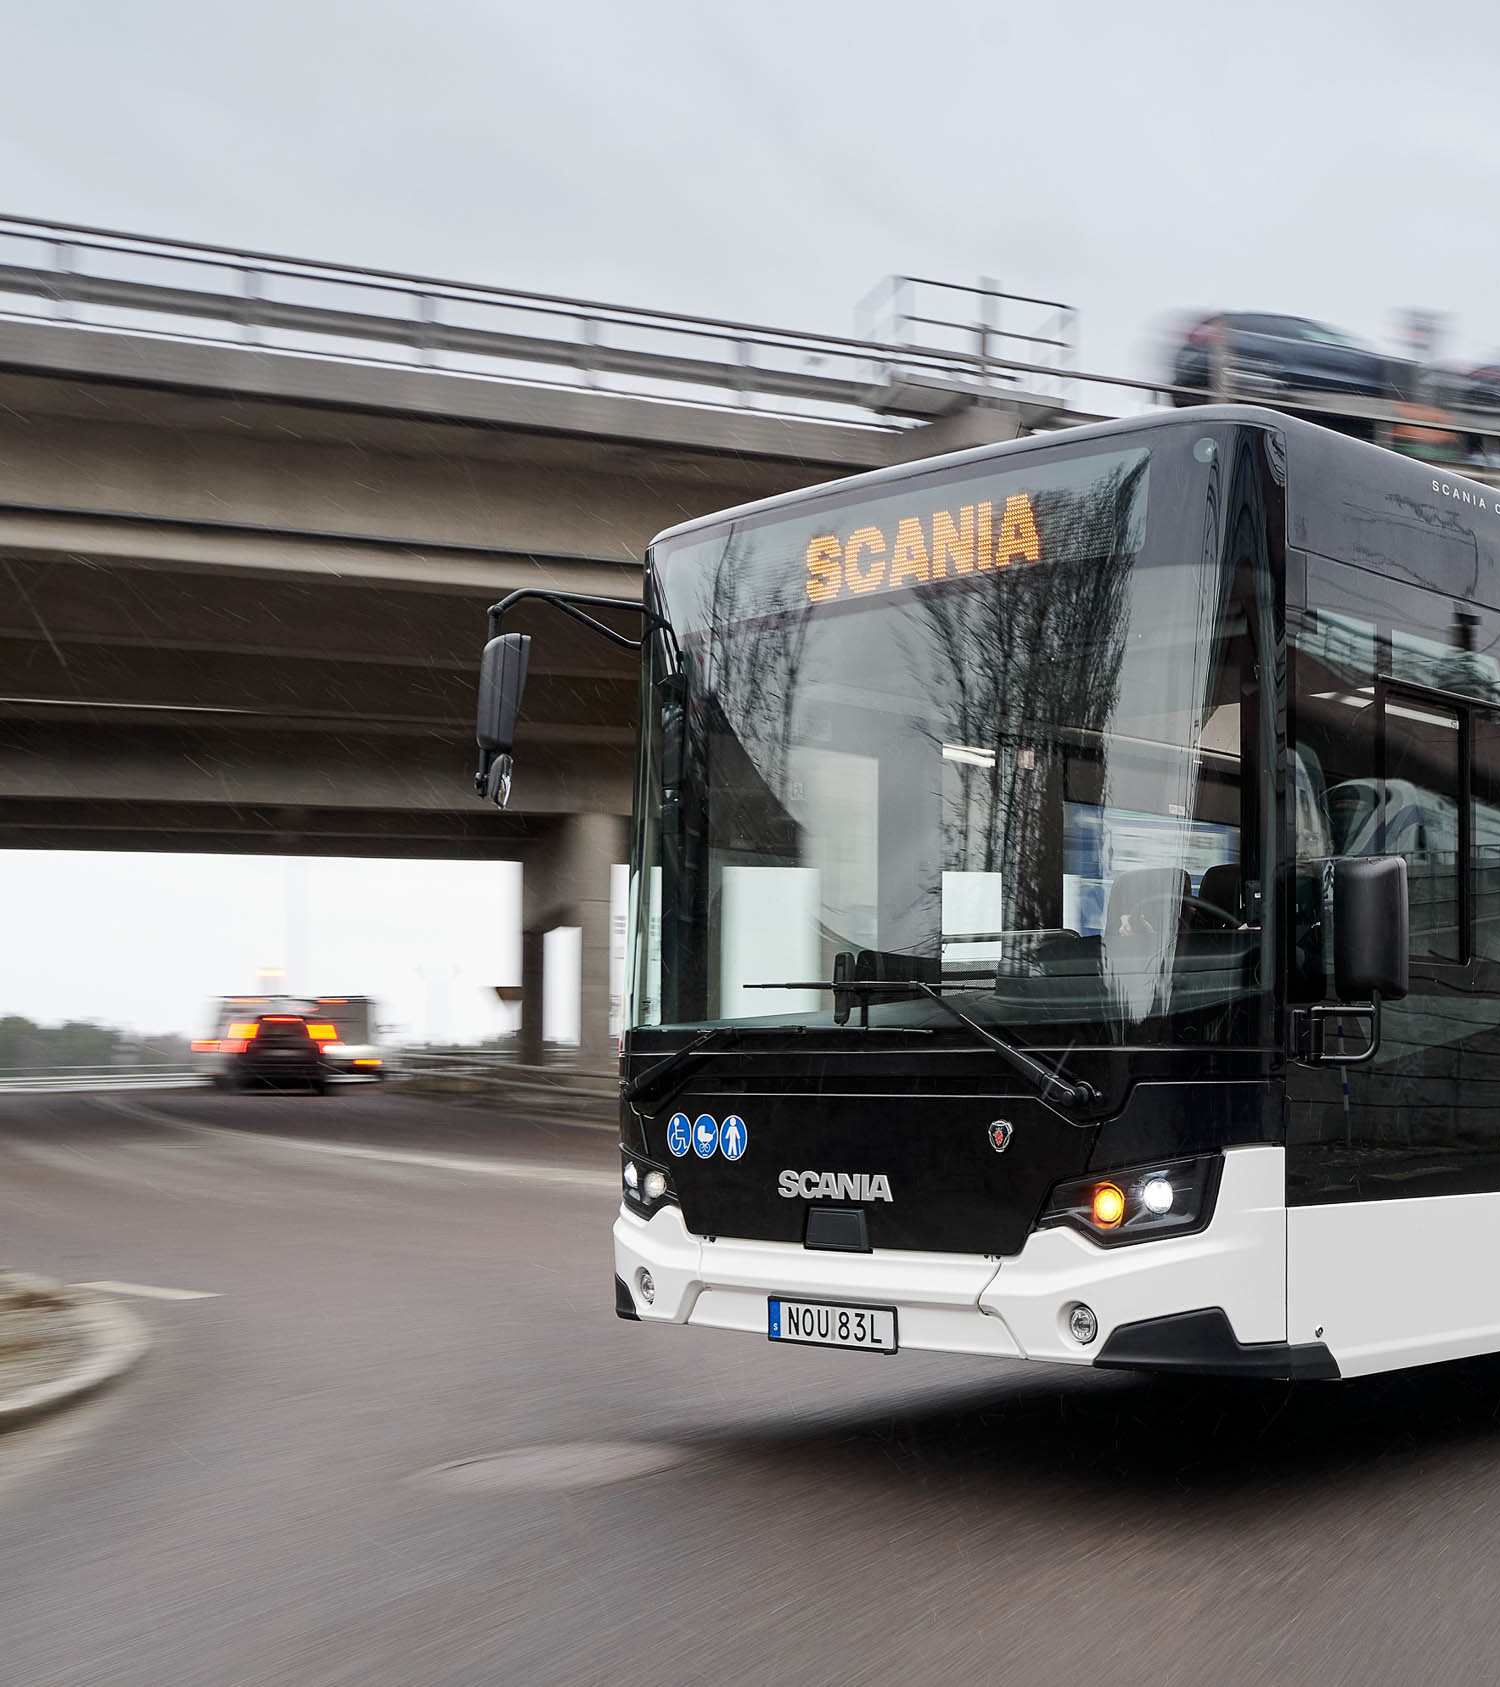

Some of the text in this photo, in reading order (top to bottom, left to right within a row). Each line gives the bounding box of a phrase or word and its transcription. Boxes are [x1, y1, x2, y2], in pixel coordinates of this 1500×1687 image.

[1432, 480, 1487, 510] SCANIA
[806, 493, 1040, 602] SCANIA
[777, 1169, 894, 1203] SCANIA
[773, 1323, 778, 1331] S
[788, 1306, 883, 1344] NOU 83L
